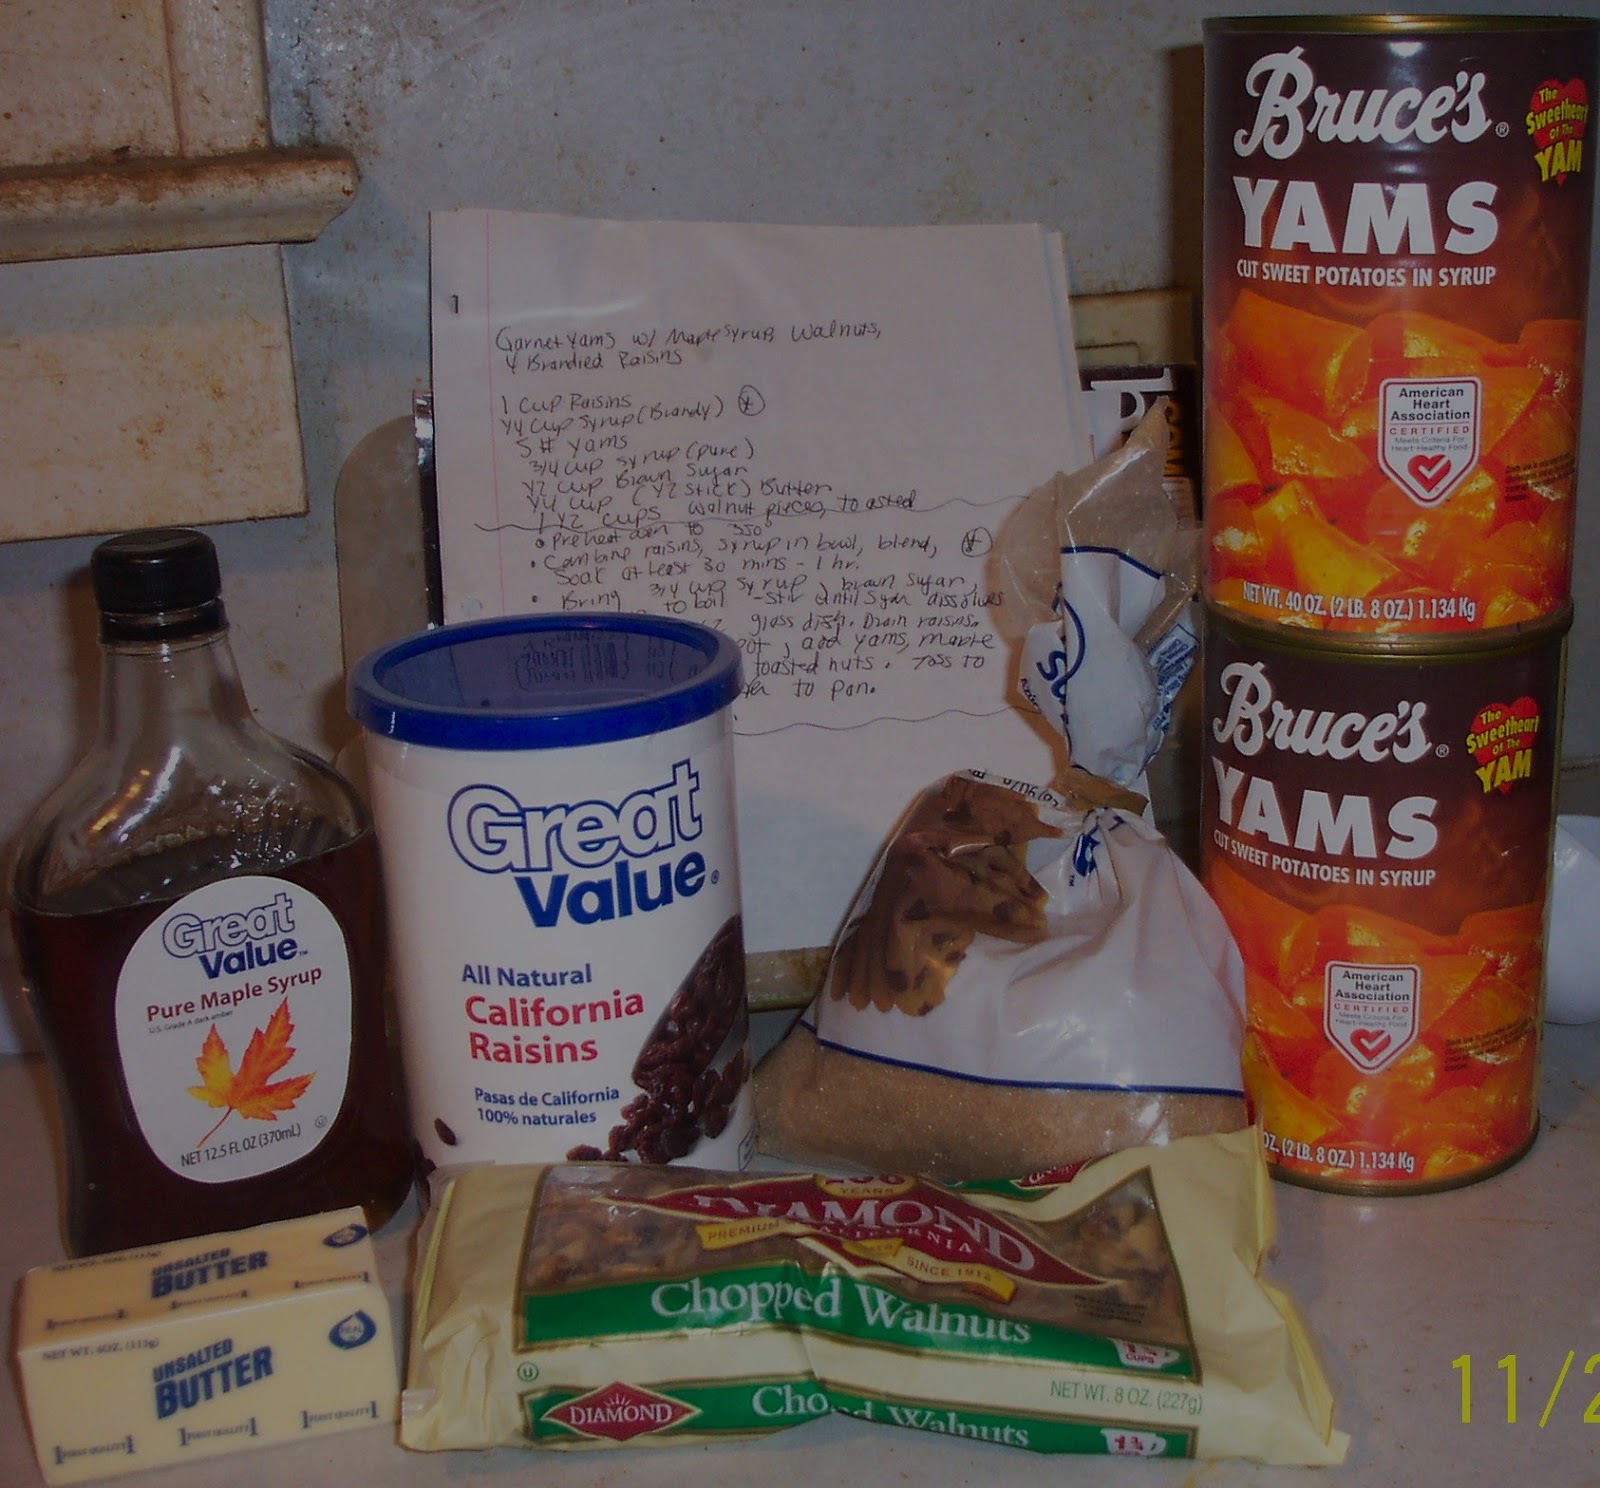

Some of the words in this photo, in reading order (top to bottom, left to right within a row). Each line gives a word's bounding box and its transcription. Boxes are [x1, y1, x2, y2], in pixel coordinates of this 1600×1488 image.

[1233, 46, 1492, 160] Bruce's
[1539, 87, 1558, 103] The
[1525, 97, 1589, 136] Sweetheart
[1534, 139, 1583, 182] YAM
[1233, 176, 1499, 255] YAMS
[1237, 259, 1259, 280] CUT
[1262, 262, 1310, 284] SWEET
[1315, 266, 1407, 287] POTATOES
[1413, 268, 1433, 287] IN
[1439, 266, 1497, 287] SYRUP
[1399, 387, 1464, 398] American
[1413, 399, 1450, 409] Heart
[1390, 426, 1469, 435] CERTIFIED
[1391, 410, 1470, 421] Association
[1243, 582, 1260, 600] NET
[1262, 587, 1283, 608] WT.
[1285, 592, 1301, 612] 40
[1304, 595, 1327, 615] OZ.
[1329, 596, 1344, 618] (2
[1347, 598, 1365, 619] LB.
[1371, 599, 1380, 619] 8
[1383, 598, 1414, 621] OZ.)
[1418, 598, 1456, 619] 1.134
[1458, 597, 1476, 622] Kg
[1213, 660, 1432, 763] Bruce's
[1479, 709, 1502, 726] The
[1466, 715, 1539, 754] Sweetheart
[1507, 737, 1521, 748] The
[1475, 748, 1532, 794] YAM
[447, 758, 703, 874] Great
[1212, 755, 1439, 860] YAMS
[1213, 829, 1229, 848] CUT
[1231, 840, 1268, 868] SWEET
[1272, 855, 1350, 884] POTATOES
[1356, 868, 1374, 885] IN
[1380, 869, 1436, 887] SYRUP
[515, 852, 706, 928] Value
[162, 892, 296, 959] Great
[199, 937, 298, 980] Value
[462, 963, 490, 985] All
[497, 963, 592, 987] Natural
[1343, 970, 1403, 981] American
[146, 1001, 195, 1022] Pure
[200, 983, 263, 1011] Maple
[268, 966, 323, 995] Syrup
[1335, 989, 1409, 1001] Association
[1355, 981, 1390, 991] Heart
[465, 989, 645, 1027] California
[1334, 1003, 1409, 1013] CERTIFIED
[469, 1032, 598, 1064] Raisins
[475, 1087, 516, 1106] Pasas
[518, 1090, 539, 1107] de
[541, 1087, 620, 1108] California
[477, 1107, 519, 1126] 100%
[522, 1109, 597, 1127] naturales
[181, 1149, 203, 1168] NET
[205, 1144, 228, 1161] 12.5
[229, 1141, 242, 1157] FL
[243, 1137, 258, 1153] OZ
[259, 1124, 302, 1148] (370mL)
[1282, 1135, 1294, 1158] (2
[1296, 1139, 1314, 1161] LB.
[1316, 1145, 1326, 1164] 8
[1328, 1146, 1355, 1168] OZ.)
[1359, 1149, 1395, 1169] 1.134
[1398, 1151, 1415, 1172] Kg
[708, 1220, 780, 1241] PREMIUM
[151, 1250, 268, 1298] BUTTER
[152, 1248, 232, 1276] UNSALTED
[907, 1256, 947, 1277] SINCE
[958, 1268, 991, 1282] 1912
[650, 1276, 842, 1322] Chopped
[855, 1283, 1032, 1344] Walnuts
[153, 1338, 233, 1382] UNSALTED
[155, 1346, 273, 1420] BUTTER
[1050, 1381, 1080, 1399] NET
[1084, 1384, 1110, 1402] WT.
[1114, 1387, 1123, 1403] 8
[1157, 1391, 1203, 1415] (227g)
[569, 1404, 673, 1425] DIAMOND
[889, 1406, 1030, 1447] Walnuts
